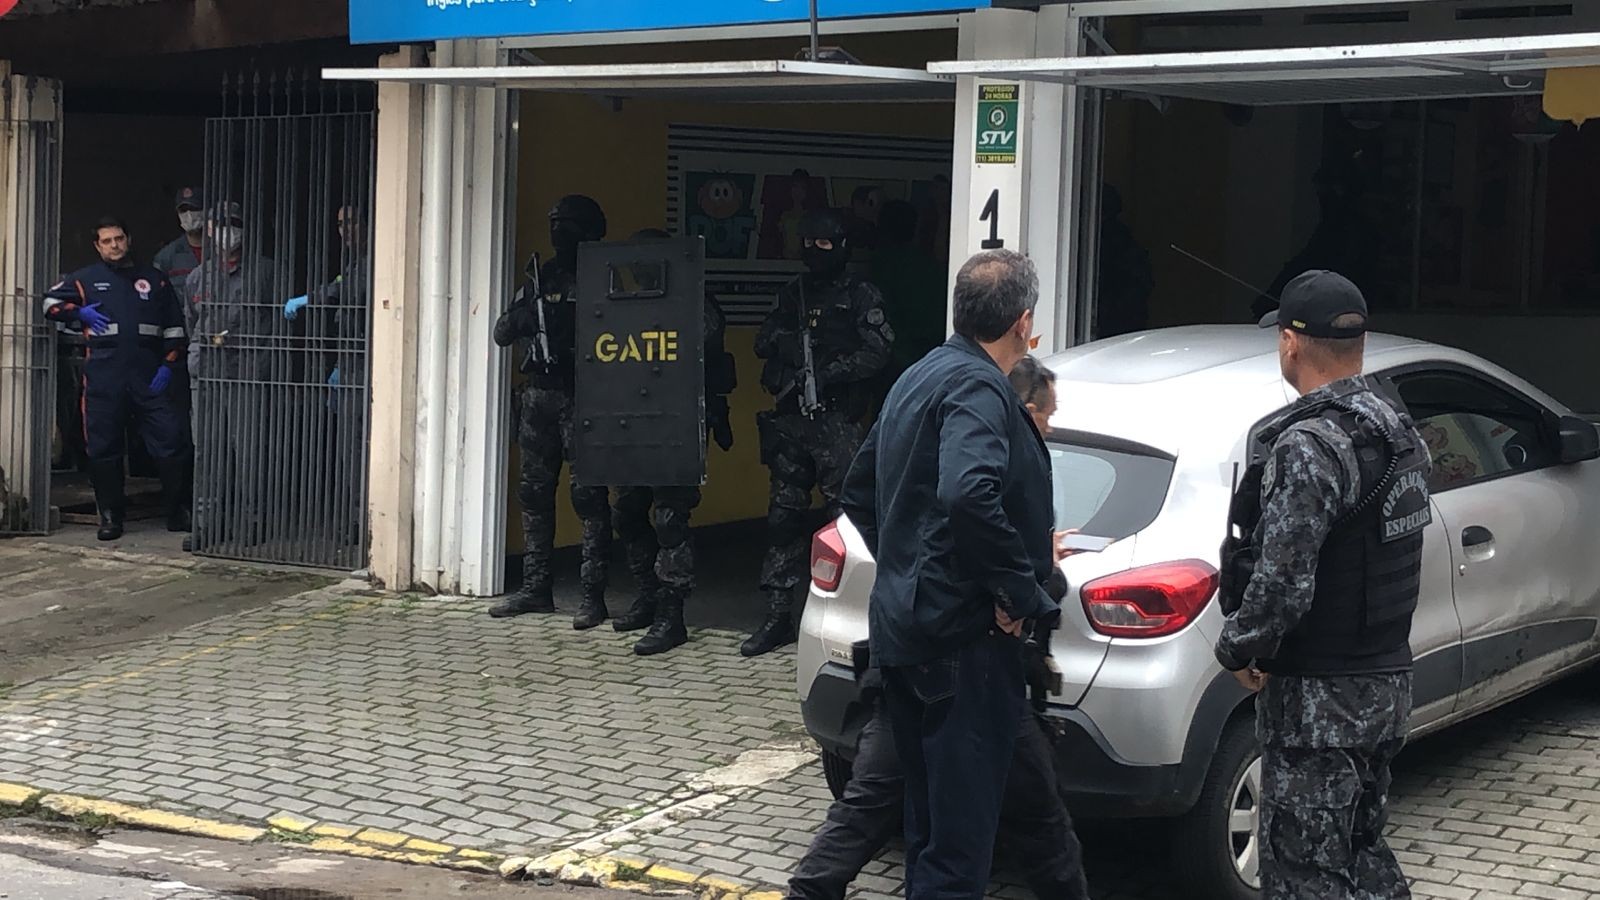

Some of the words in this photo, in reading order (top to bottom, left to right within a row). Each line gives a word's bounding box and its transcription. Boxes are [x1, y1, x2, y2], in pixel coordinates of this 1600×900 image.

[979, 131, 1014, 145] STV
[979, 188, 1005, 249] 1
[595, 331, 678, 362] GATE
[1385, 506, 1430, 537] ESPECIAIS
